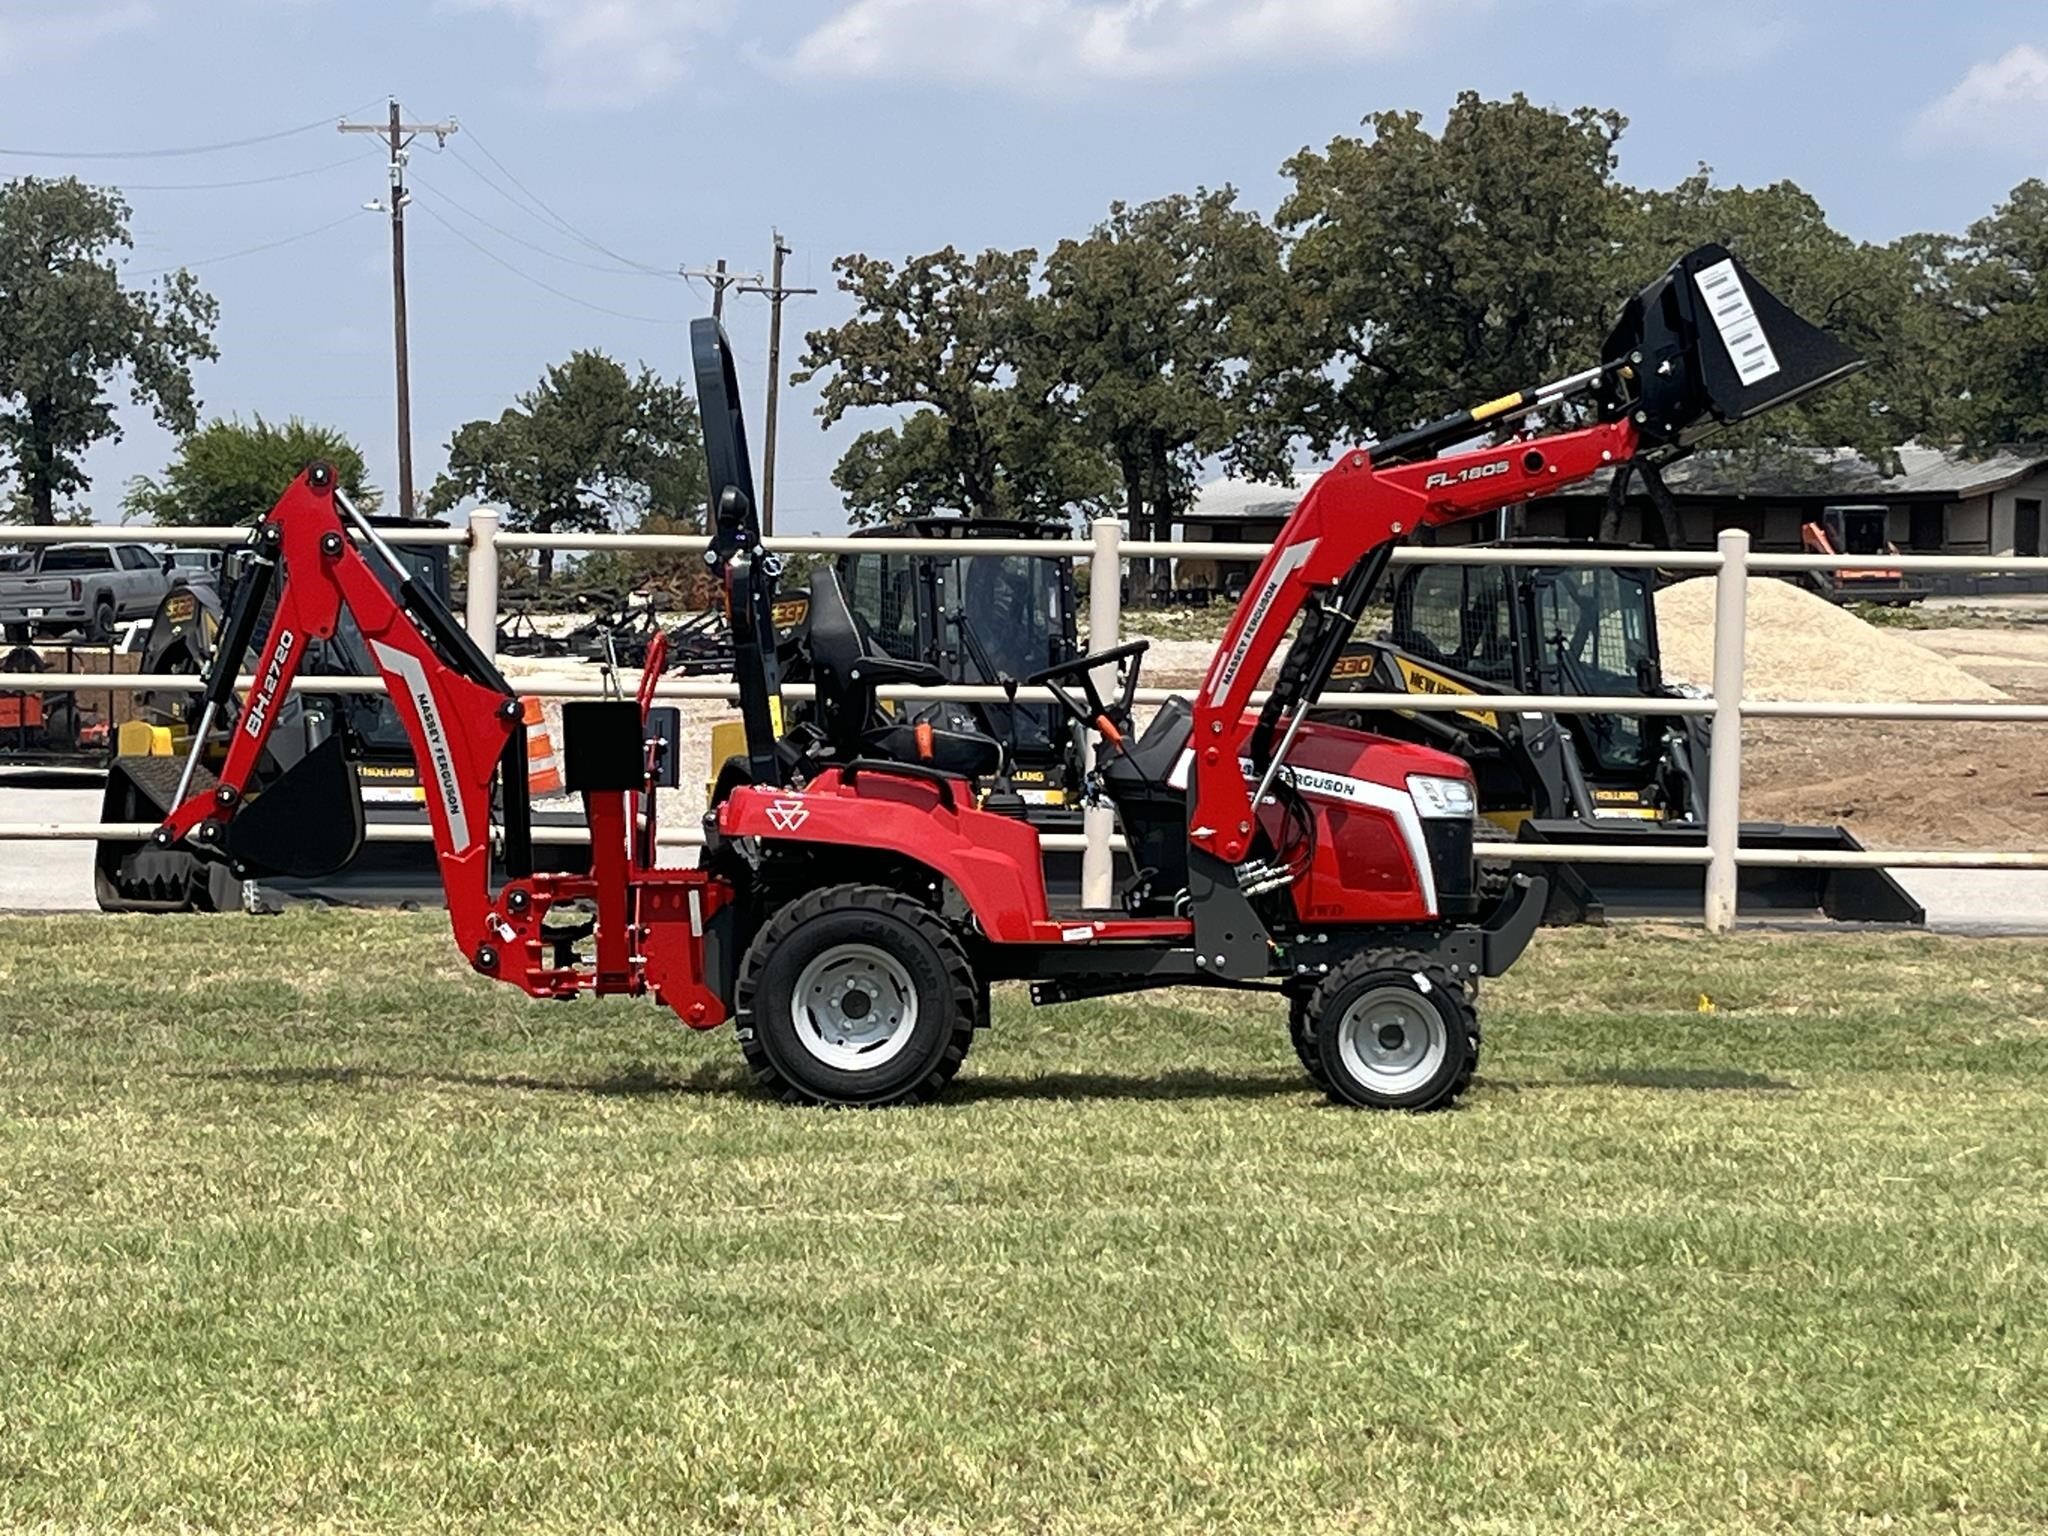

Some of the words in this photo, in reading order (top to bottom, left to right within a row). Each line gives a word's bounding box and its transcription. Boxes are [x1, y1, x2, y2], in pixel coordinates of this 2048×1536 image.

[1223, 640, 1248, 685] MASSEY
[1244, 582, 1278, 638] FERGUSON
[416, 693, 441, 743] MASSEY
[434, 747, 460, 815] FERGUSON
